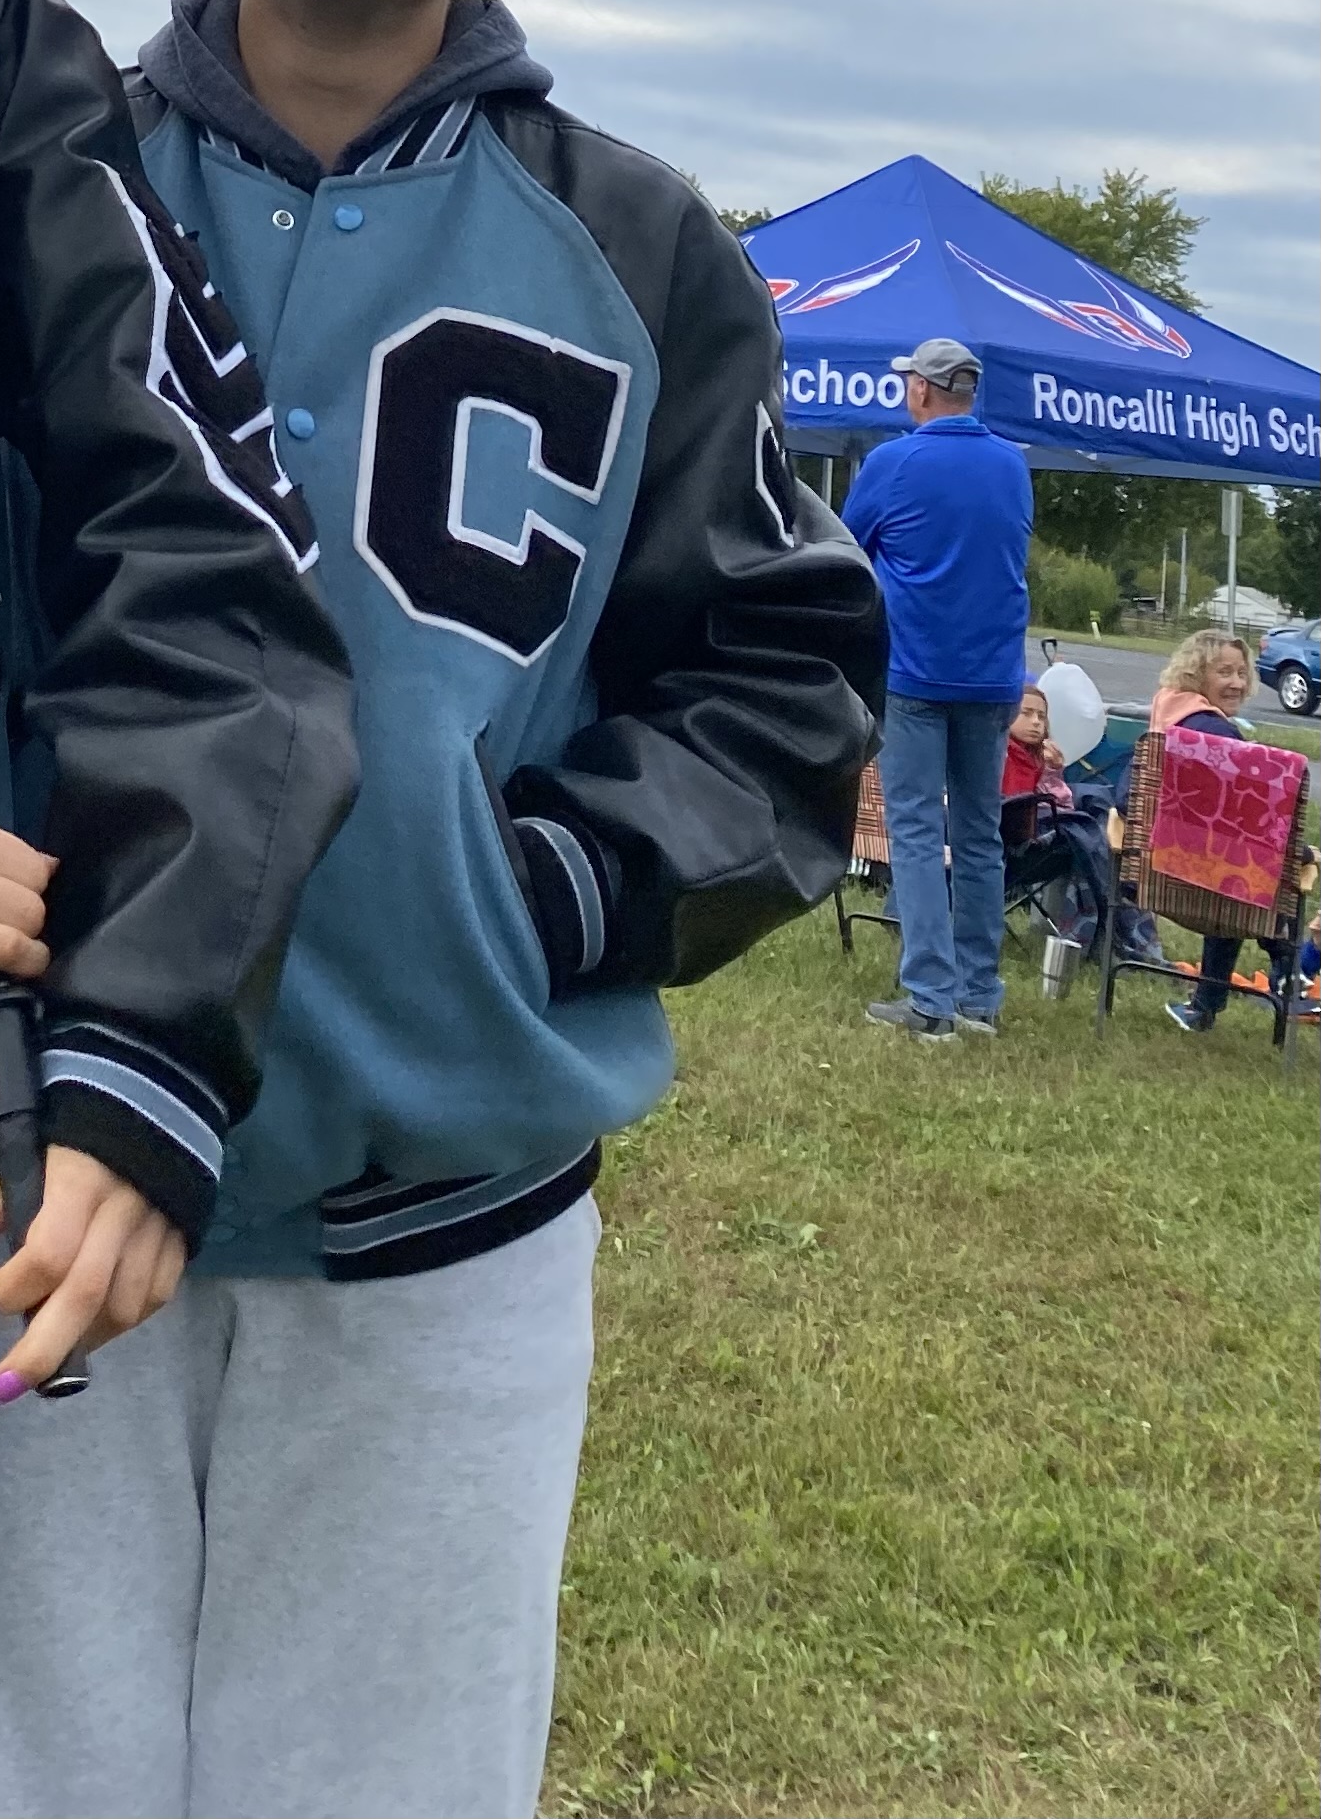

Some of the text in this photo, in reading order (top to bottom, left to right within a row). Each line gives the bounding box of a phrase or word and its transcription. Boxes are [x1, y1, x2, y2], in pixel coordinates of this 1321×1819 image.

[782, 358, 906, 409] choo
[1033, 372, 1177, 436] Roncalli
[1185, 394, 1261, 457] High
[354, 307, 631, 667] C
